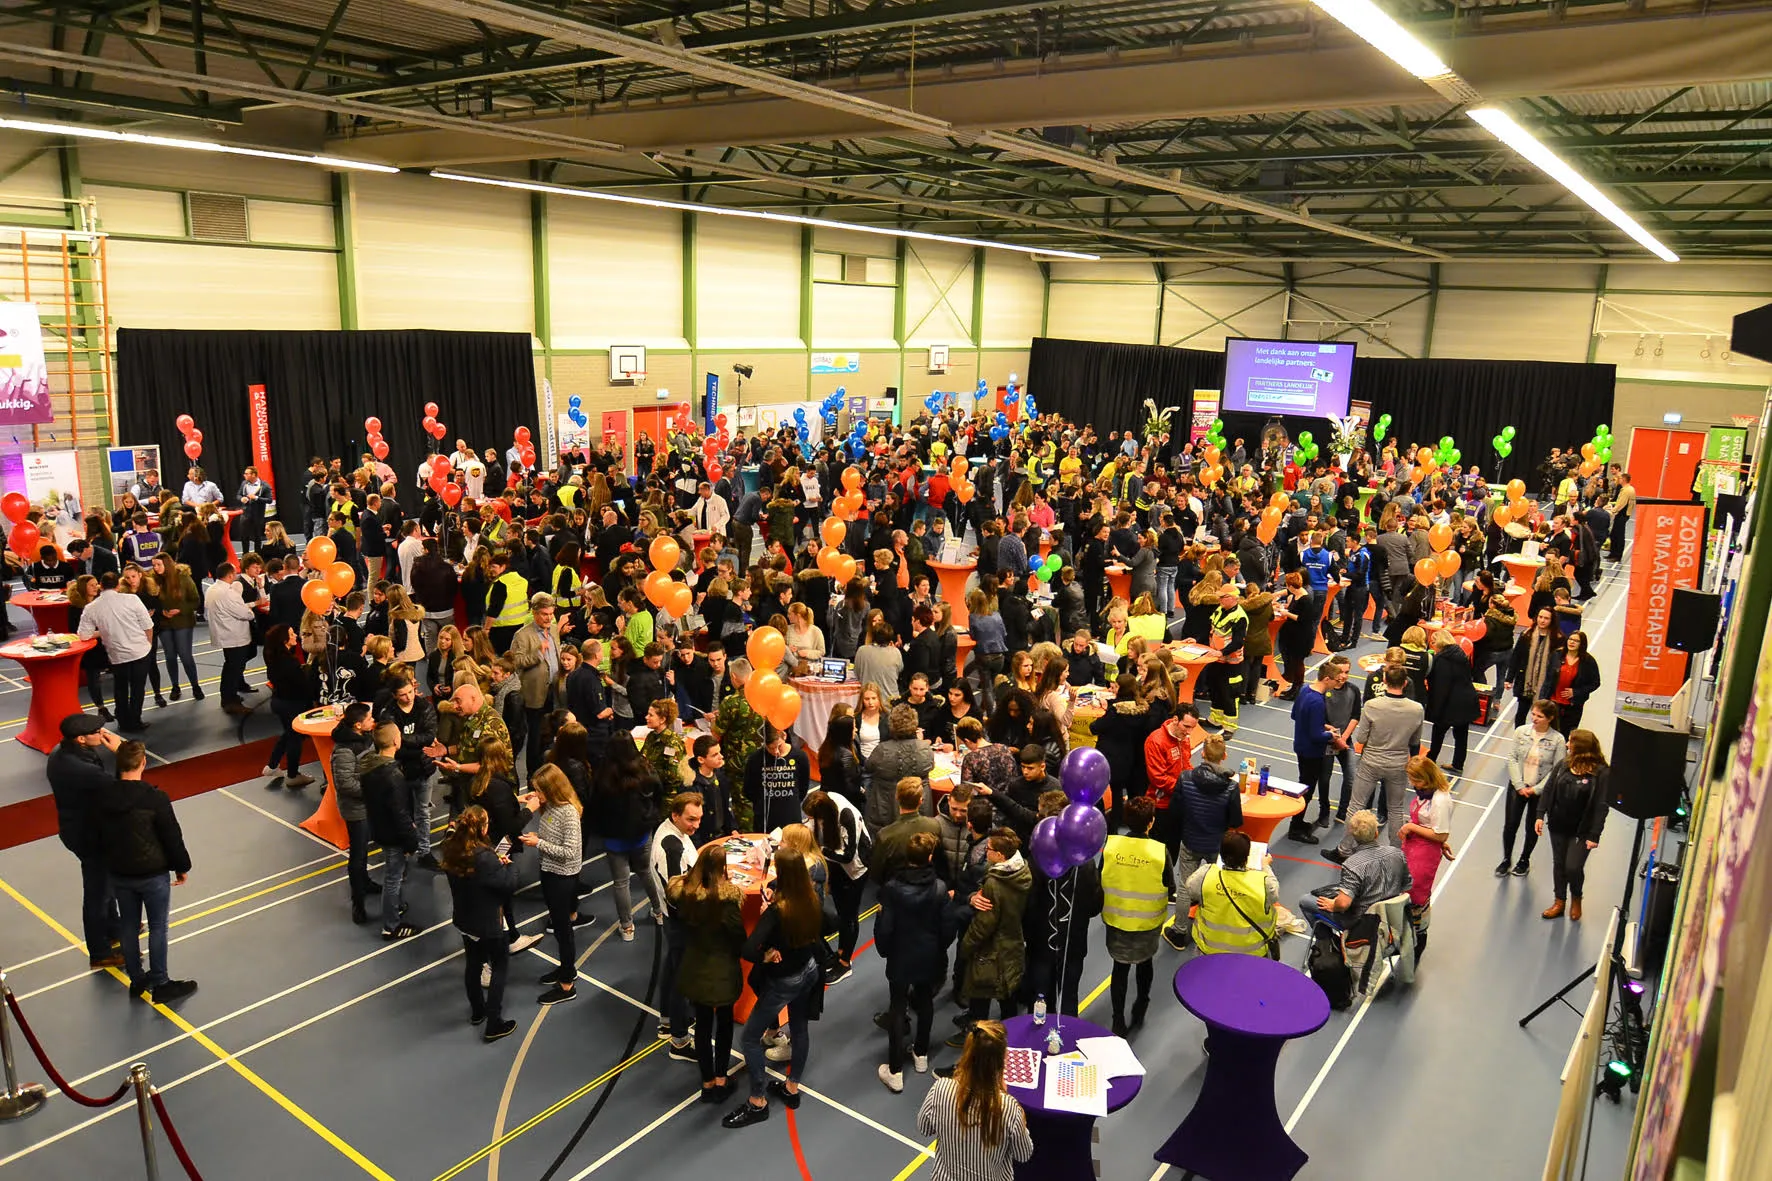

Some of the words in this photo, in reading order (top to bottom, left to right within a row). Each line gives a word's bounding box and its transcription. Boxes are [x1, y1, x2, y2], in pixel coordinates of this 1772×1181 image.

[1270, 348, 1286, 356] dank
[255, 403, 269, 462] ECONOMIE
[1656, 515, 1674, 529] &
[139, 540, 159, 550] CREW
[1673, 515, 1699, 573] ZORG,
[1643, 533, 1673, 671] MAATSCHAPPIJ
[761, 772, 794, 780] SCOTCH
